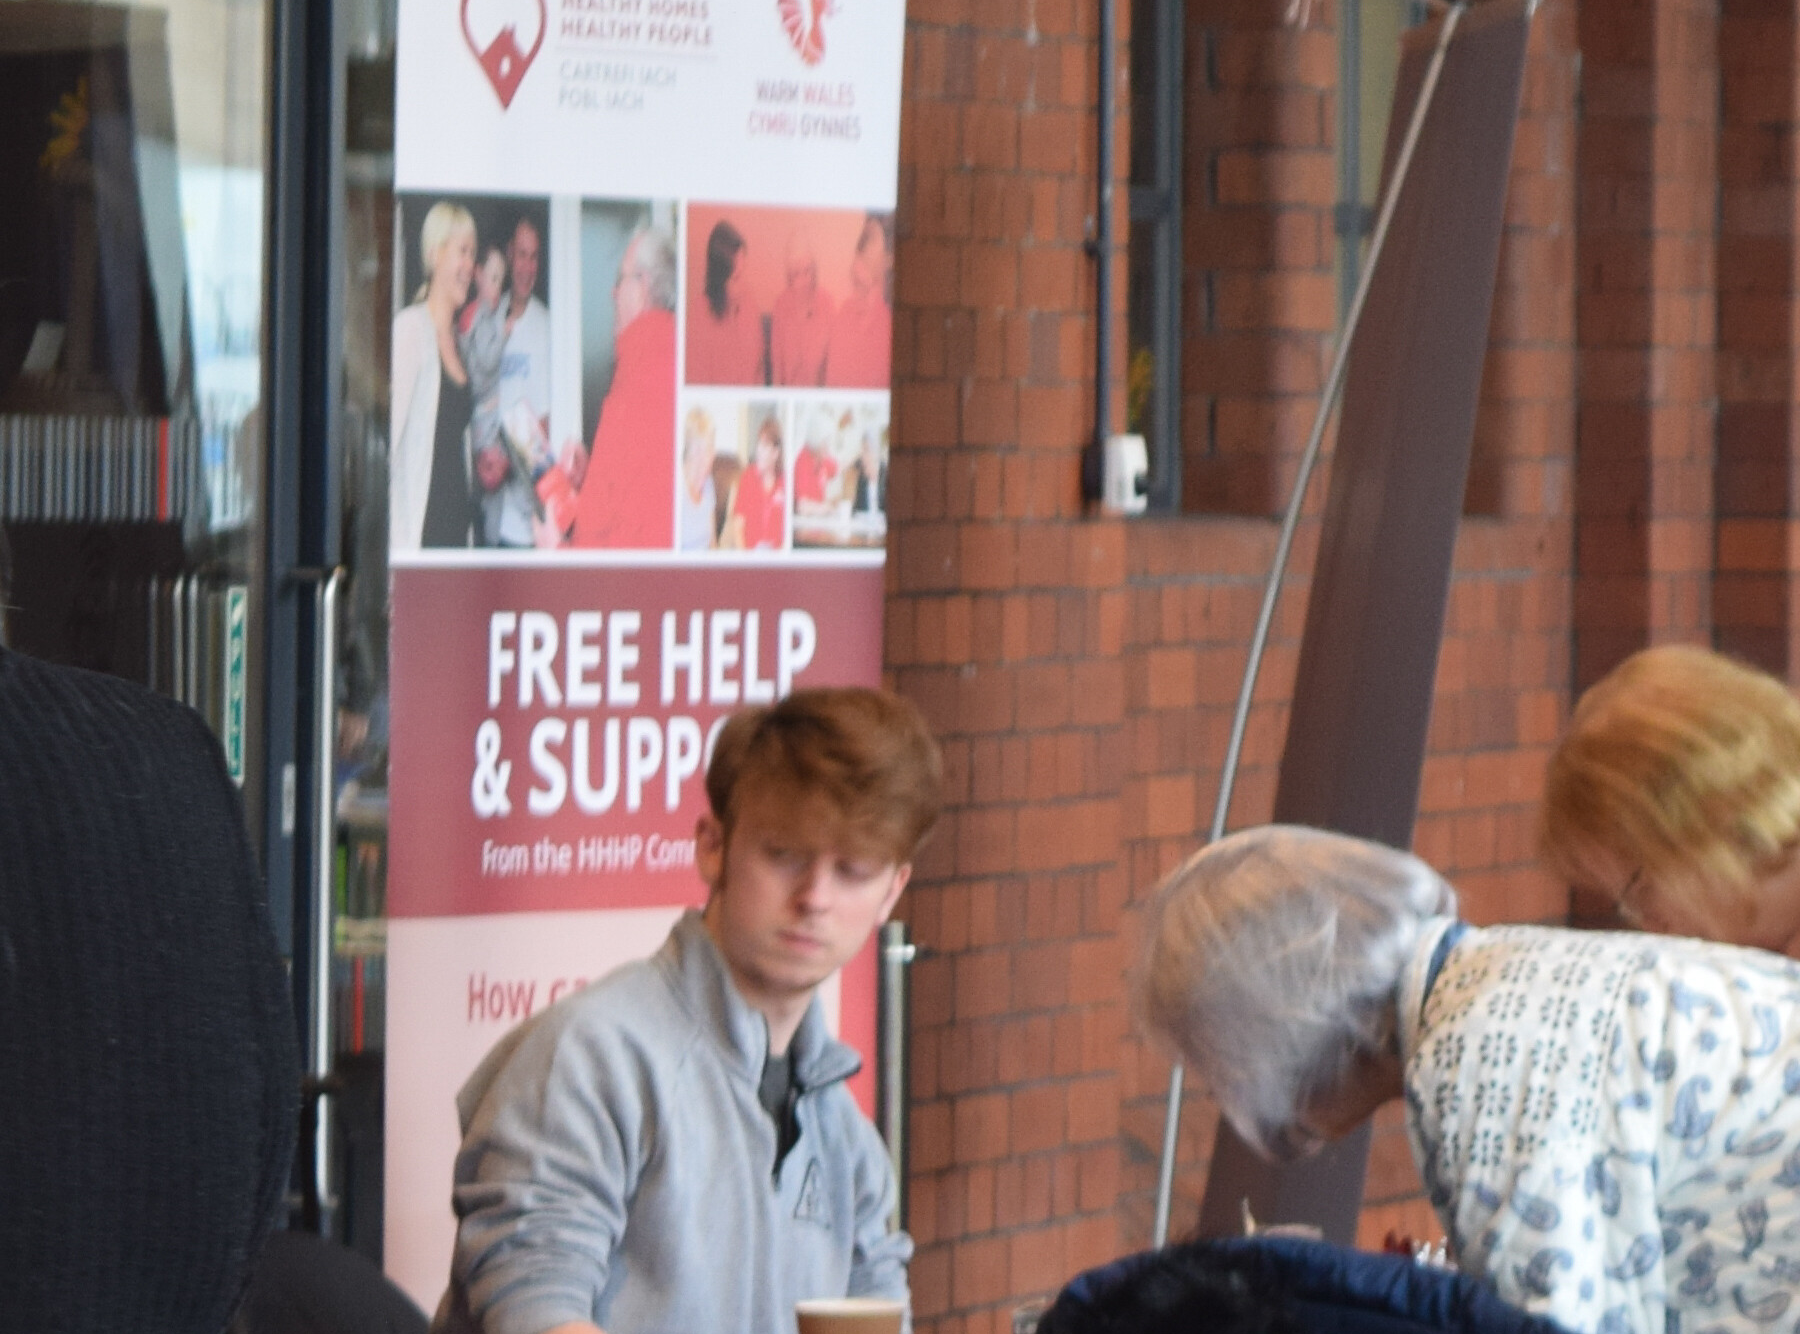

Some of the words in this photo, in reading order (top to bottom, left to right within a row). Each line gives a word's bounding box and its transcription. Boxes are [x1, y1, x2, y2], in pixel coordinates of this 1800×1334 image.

[560, 17, 641, 41] HEALTHY
[647, 22, 713, 47] PEOPLE
[756, 79, 799, 104] WARM
[803, 82, 856, 108] WALES
[487, 610, 641, 708] FREE
[660, 608, 817, 705] HELP
[471, 718, 511, 817] &
[527, 715, 732, 815] SUPP
[534, 836, 572, 876] the
[577, 834, 642, 873] HHHP
[467, 972, 536, 1022] How
